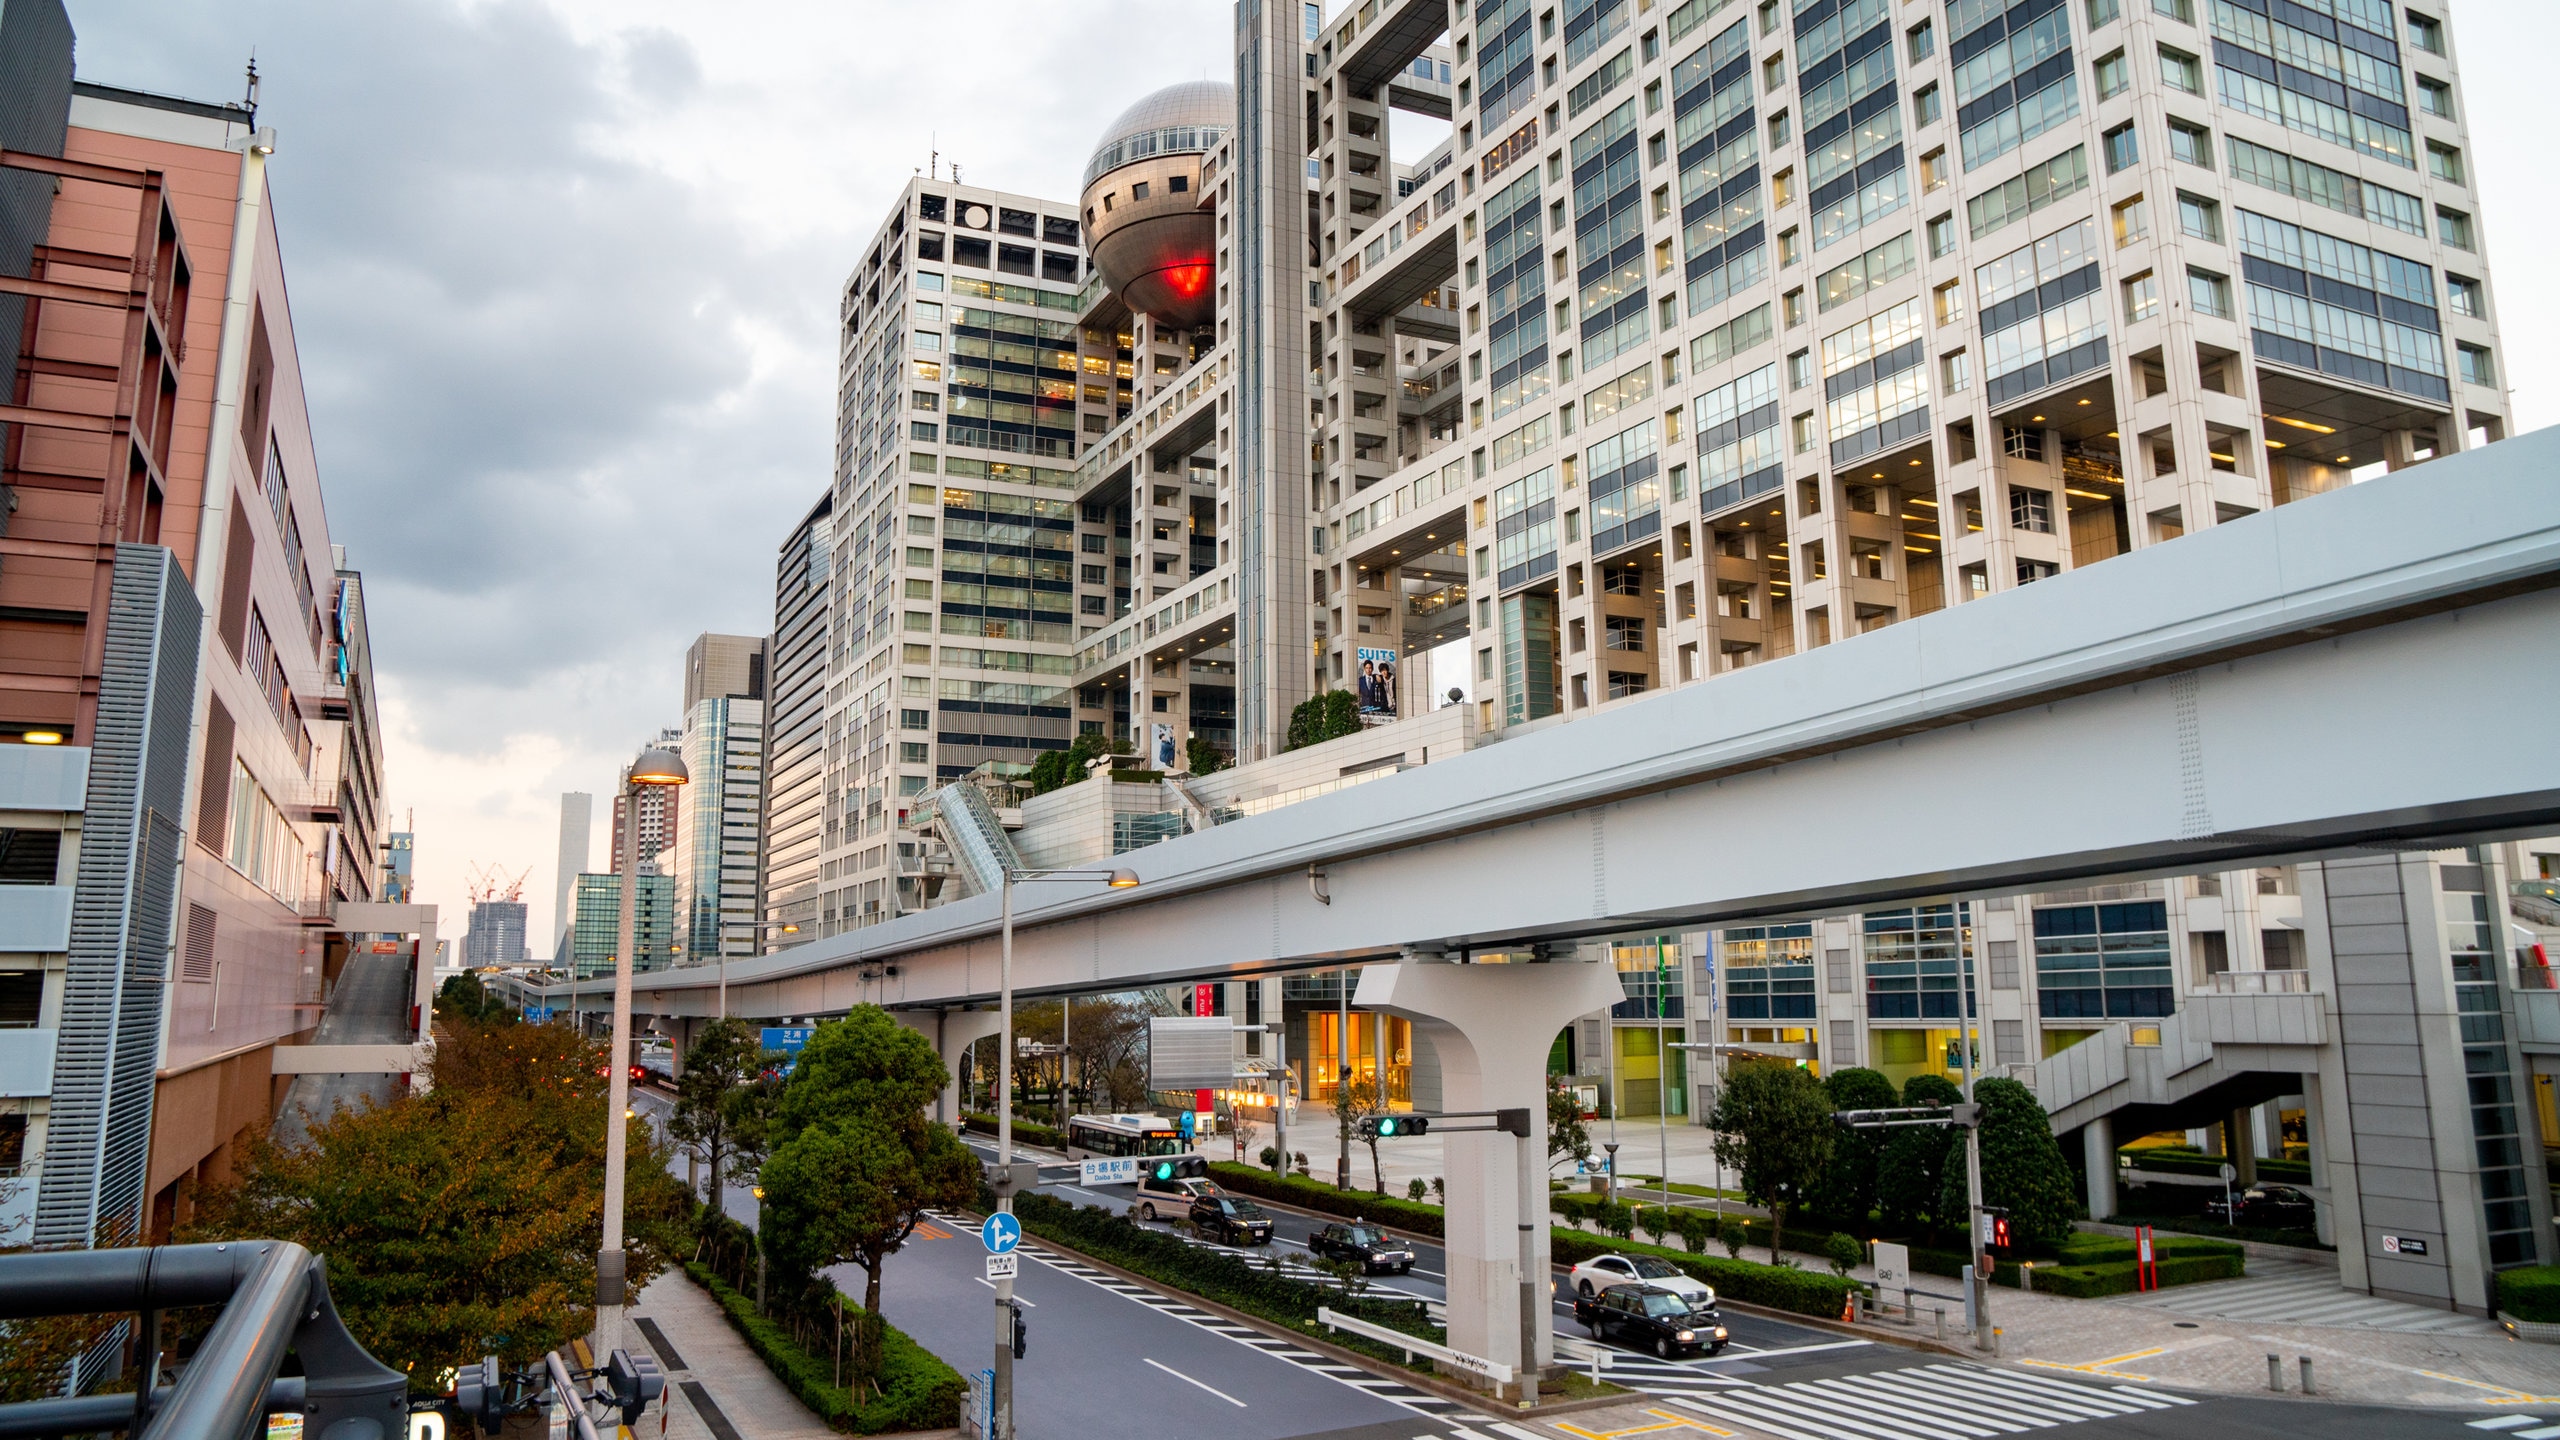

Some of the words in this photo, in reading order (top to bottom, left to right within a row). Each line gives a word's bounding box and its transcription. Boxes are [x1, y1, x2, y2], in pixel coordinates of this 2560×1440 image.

[1358, 648, 1396, 662] SUITS
[1085, 1160, 1133, 1175] 台場駅前
